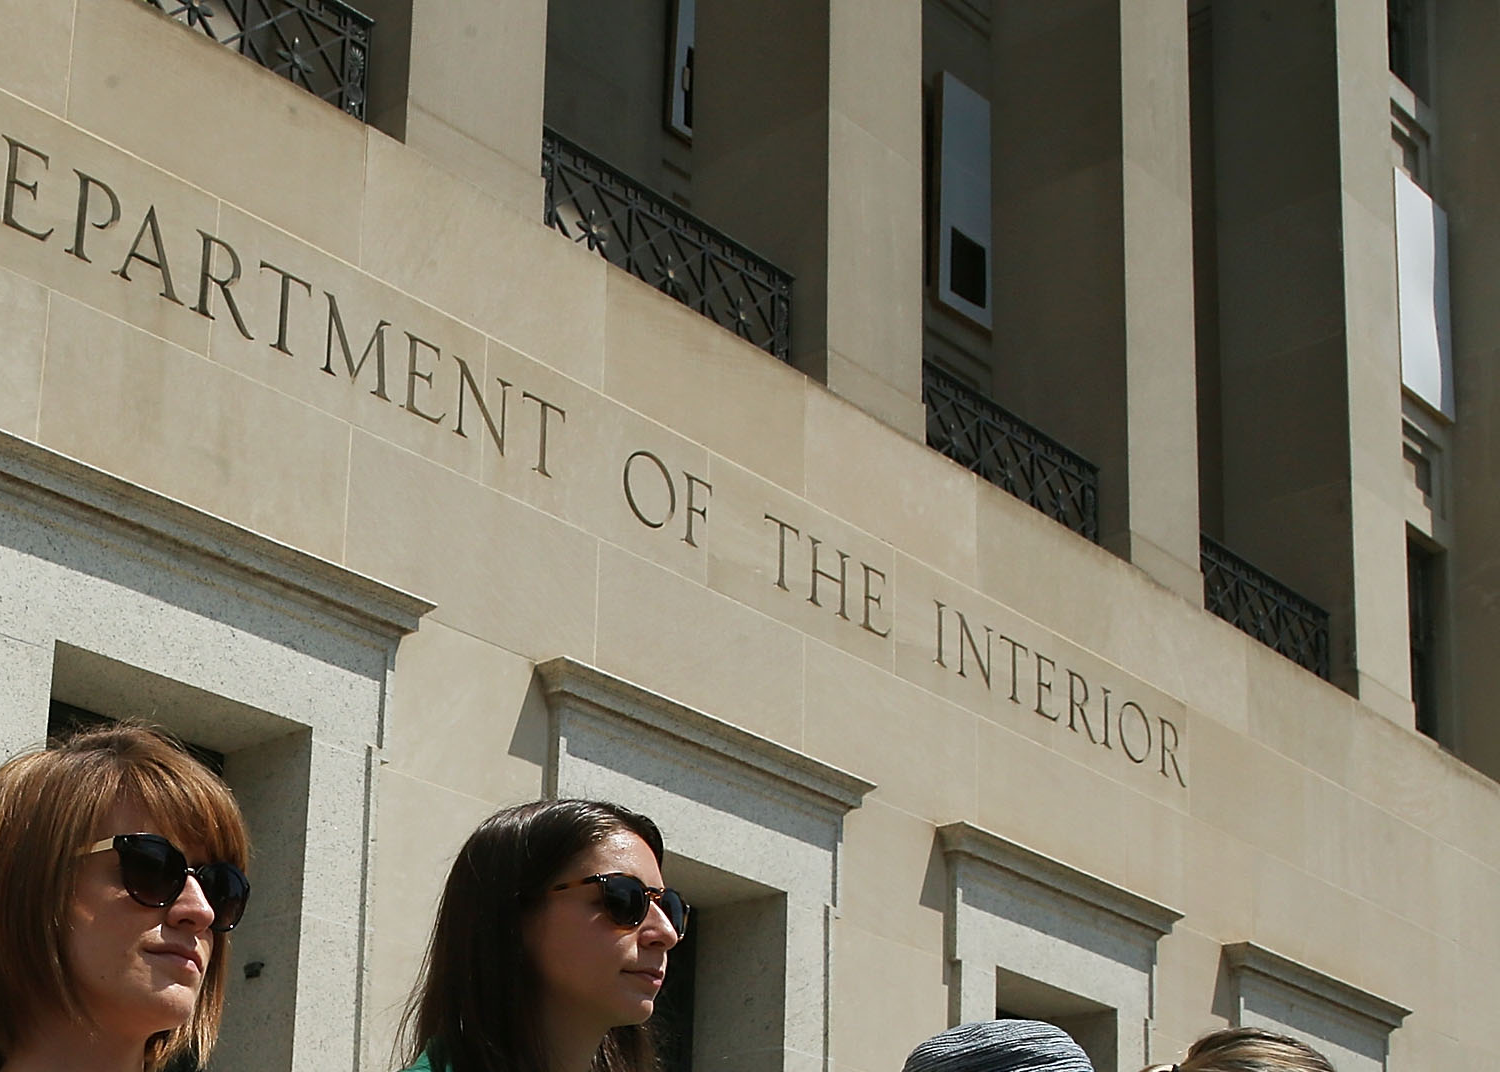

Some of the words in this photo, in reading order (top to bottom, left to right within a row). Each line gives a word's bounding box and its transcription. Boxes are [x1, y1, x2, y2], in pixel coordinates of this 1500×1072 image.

[623, 450, 713, 548] OF
[764, 513, 891, 638] THE
[933, 599, 1187, 788] INTERIOR
